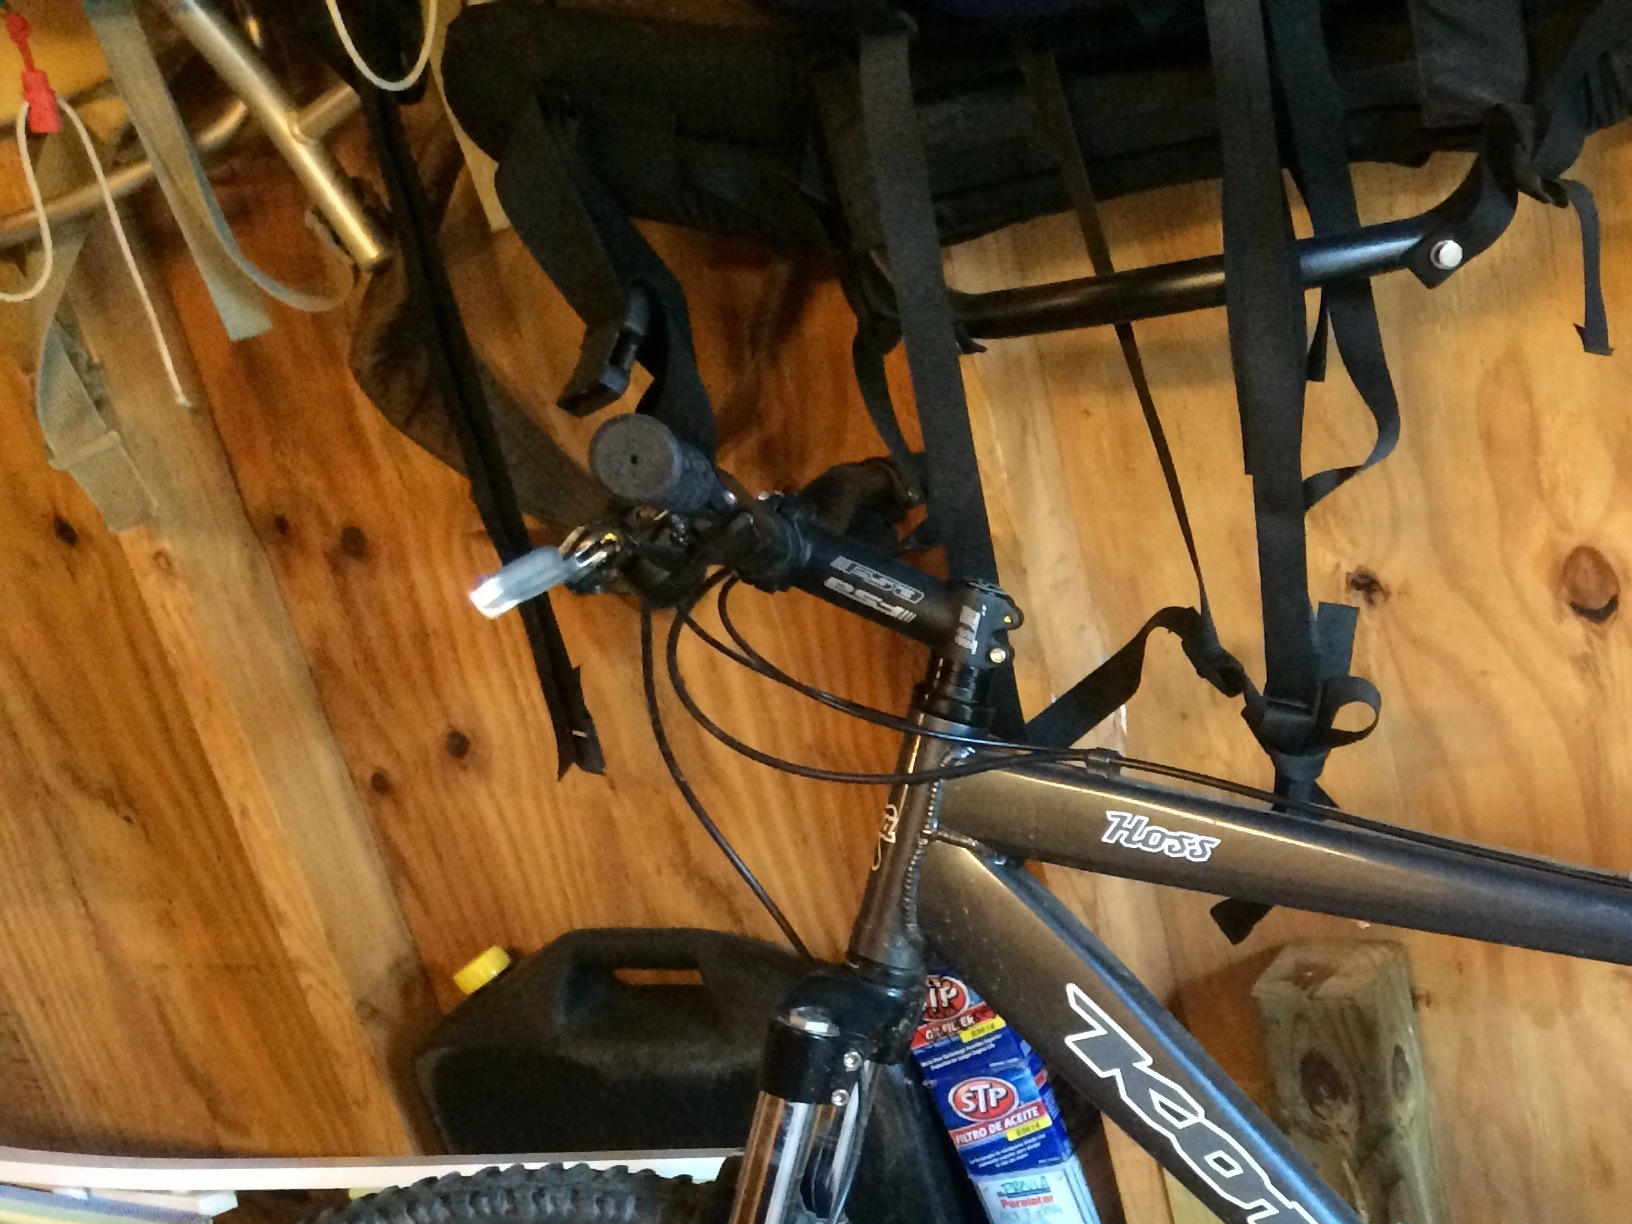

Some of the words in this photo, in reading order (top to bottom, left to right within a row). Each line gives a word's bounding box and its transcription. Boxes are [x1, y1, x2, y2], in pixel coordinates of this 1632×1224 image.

[1101, 810, 1221, 862] Hoss
[961, 1083, 1008, 1113] STP
[956, 1127, 987, 1144] FILTRO
[988, 1120, 1003, 1134] DE
[1004, 1106, 1040, 1129] ACEITE
[1000, 1195, 1054, 1210] Purolator
